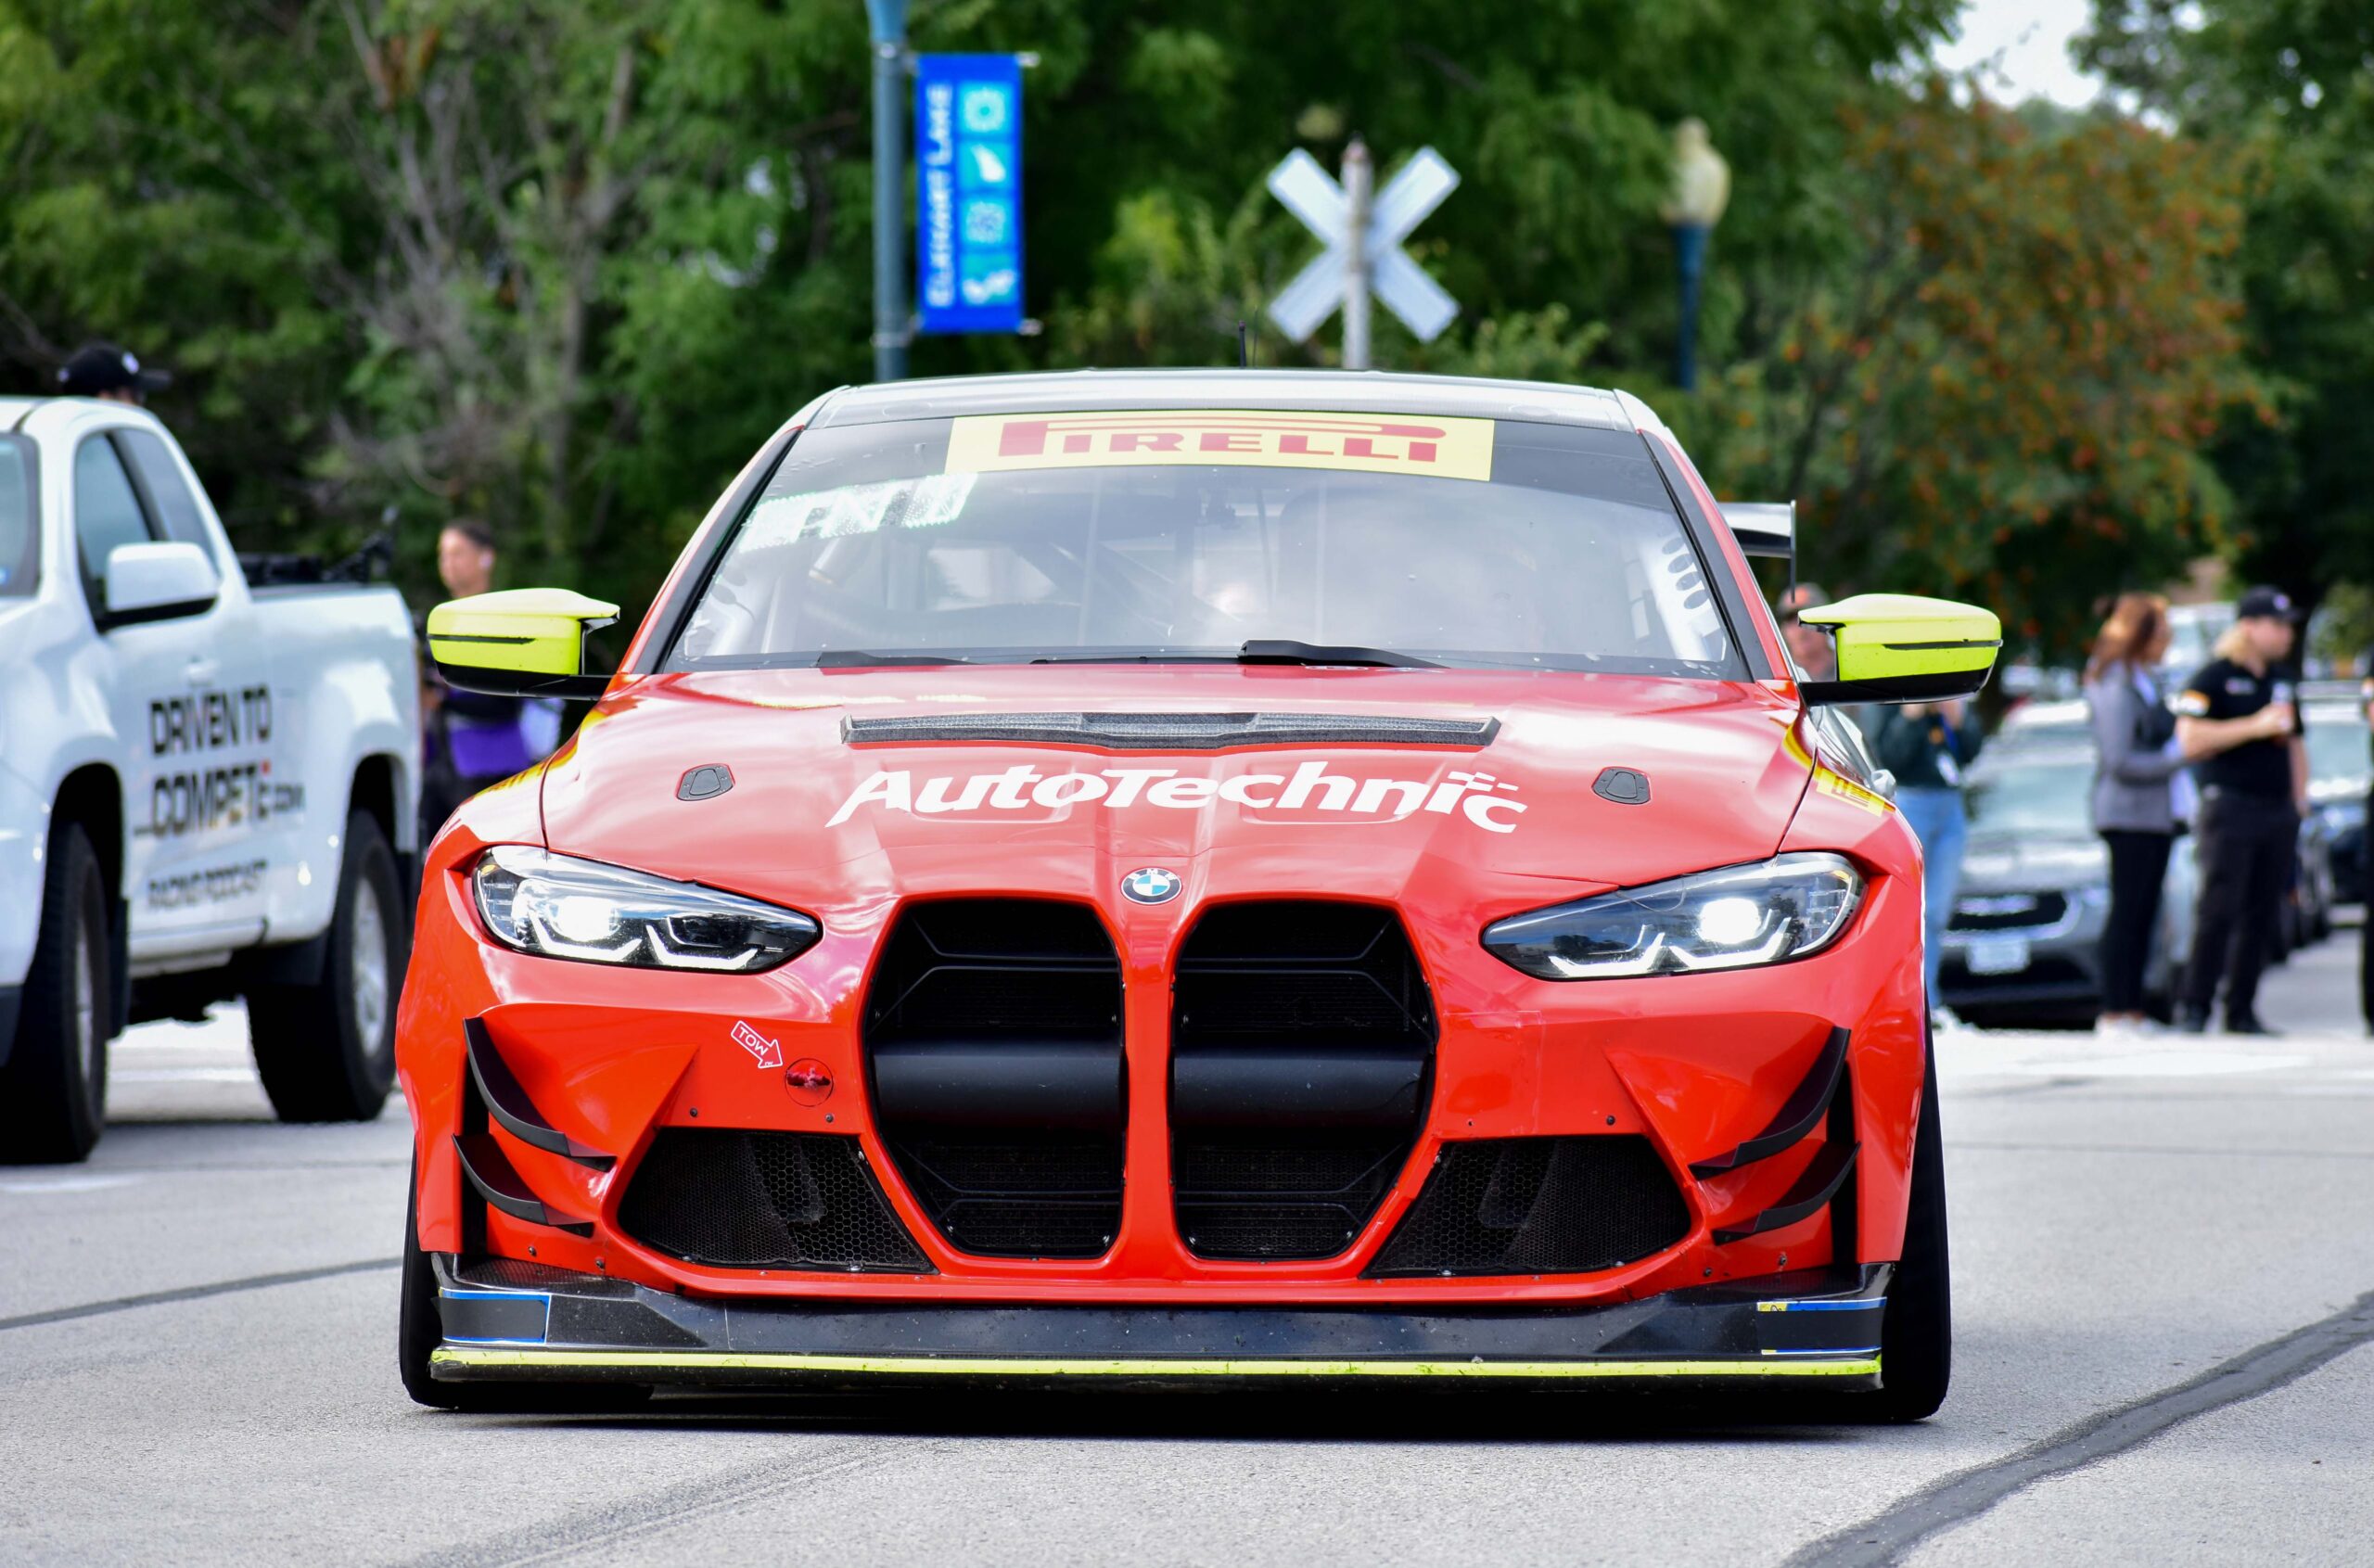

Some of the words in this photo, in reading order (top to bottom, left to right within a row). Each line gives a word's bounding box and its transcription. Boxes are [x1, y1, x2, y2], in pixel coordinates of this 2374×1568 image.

[998, 416, 1446, 463] PIRELLI
[150, 693, 238, 757] DRIVEN
[243, 683, 271, 743] TO
[739, 1026, 769, 1056] TOW
